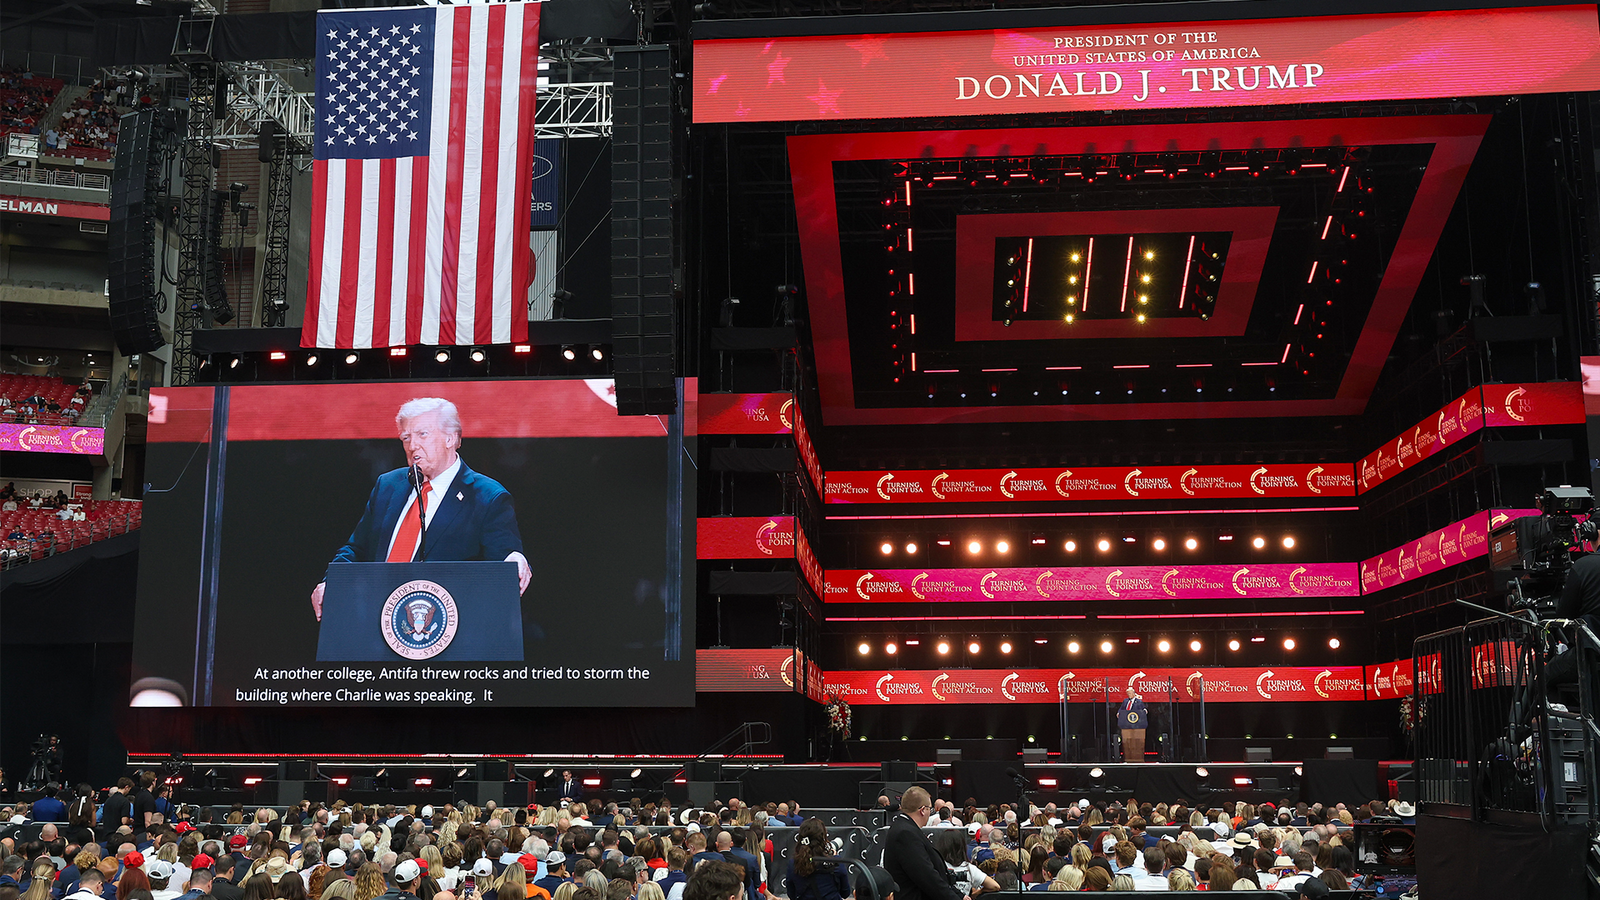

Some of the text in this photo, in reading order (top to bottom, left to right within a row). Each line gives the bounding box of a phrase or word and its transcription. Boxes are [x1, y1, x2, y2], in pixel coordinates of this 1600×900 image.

[1054, 32, 1218, 48] PRESIDENT OF THE
[1013, 47, 1261, 67] UNITED STATES OF AMERICA
[955, 63, 1324, 102] DONALD J. TRUMP
[0, 200, 58, 214] ELMAN
[20, 488, 52, 497] SHOP
[384, 584, 420, 616] PRESIDENT
[440, 594, 455, 626] UNITED
[424, 633, 450, 656] STATES
[254, 667, 650, 682] At another college, Antifa threw rocks and tried to storm the
[236, 689, 492, 704] building where Charlie was speaking. It
